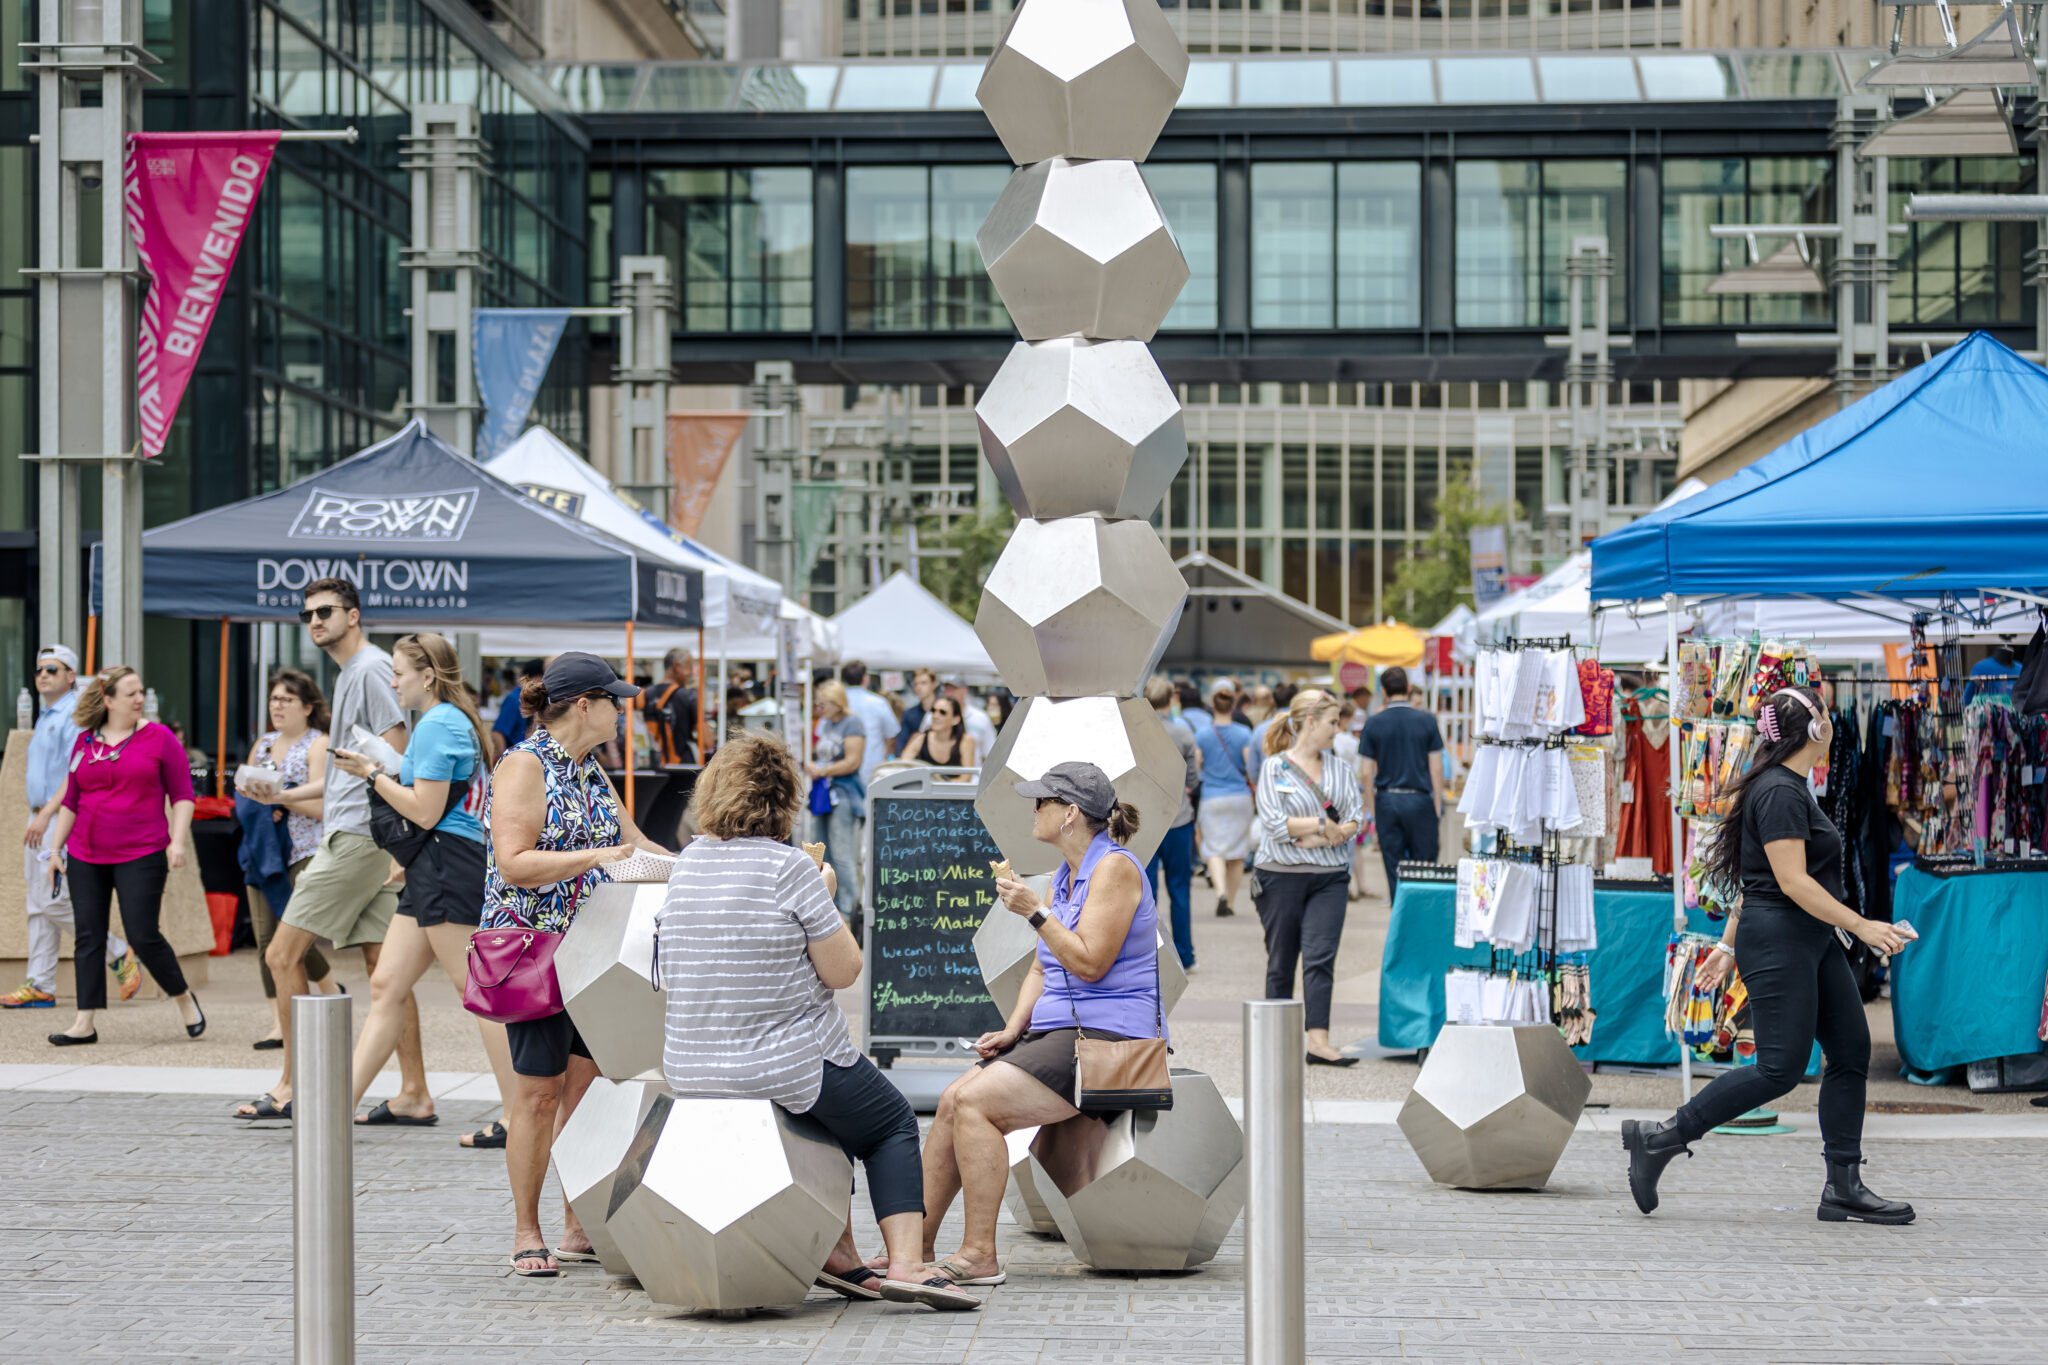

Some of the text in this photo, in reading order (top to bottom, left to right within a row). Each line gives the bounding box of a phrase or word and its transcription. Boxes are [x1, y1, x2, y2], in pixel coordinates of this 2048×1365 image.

[164, 154, 260, 357] BIENVENIDO
[519, 325, 558, 392] PLAZA
[312, 494, 467, 516] DOWN
[314, 513, 460, 532] TOWN
[257, 558, 468, 592] DOWNTOWN
[368, 593, 467, 608] Minnesota
[942, 864, 984, 881] Mike
[975, 889, 993, 906] The
[937, 941, 966, 954] Wait
